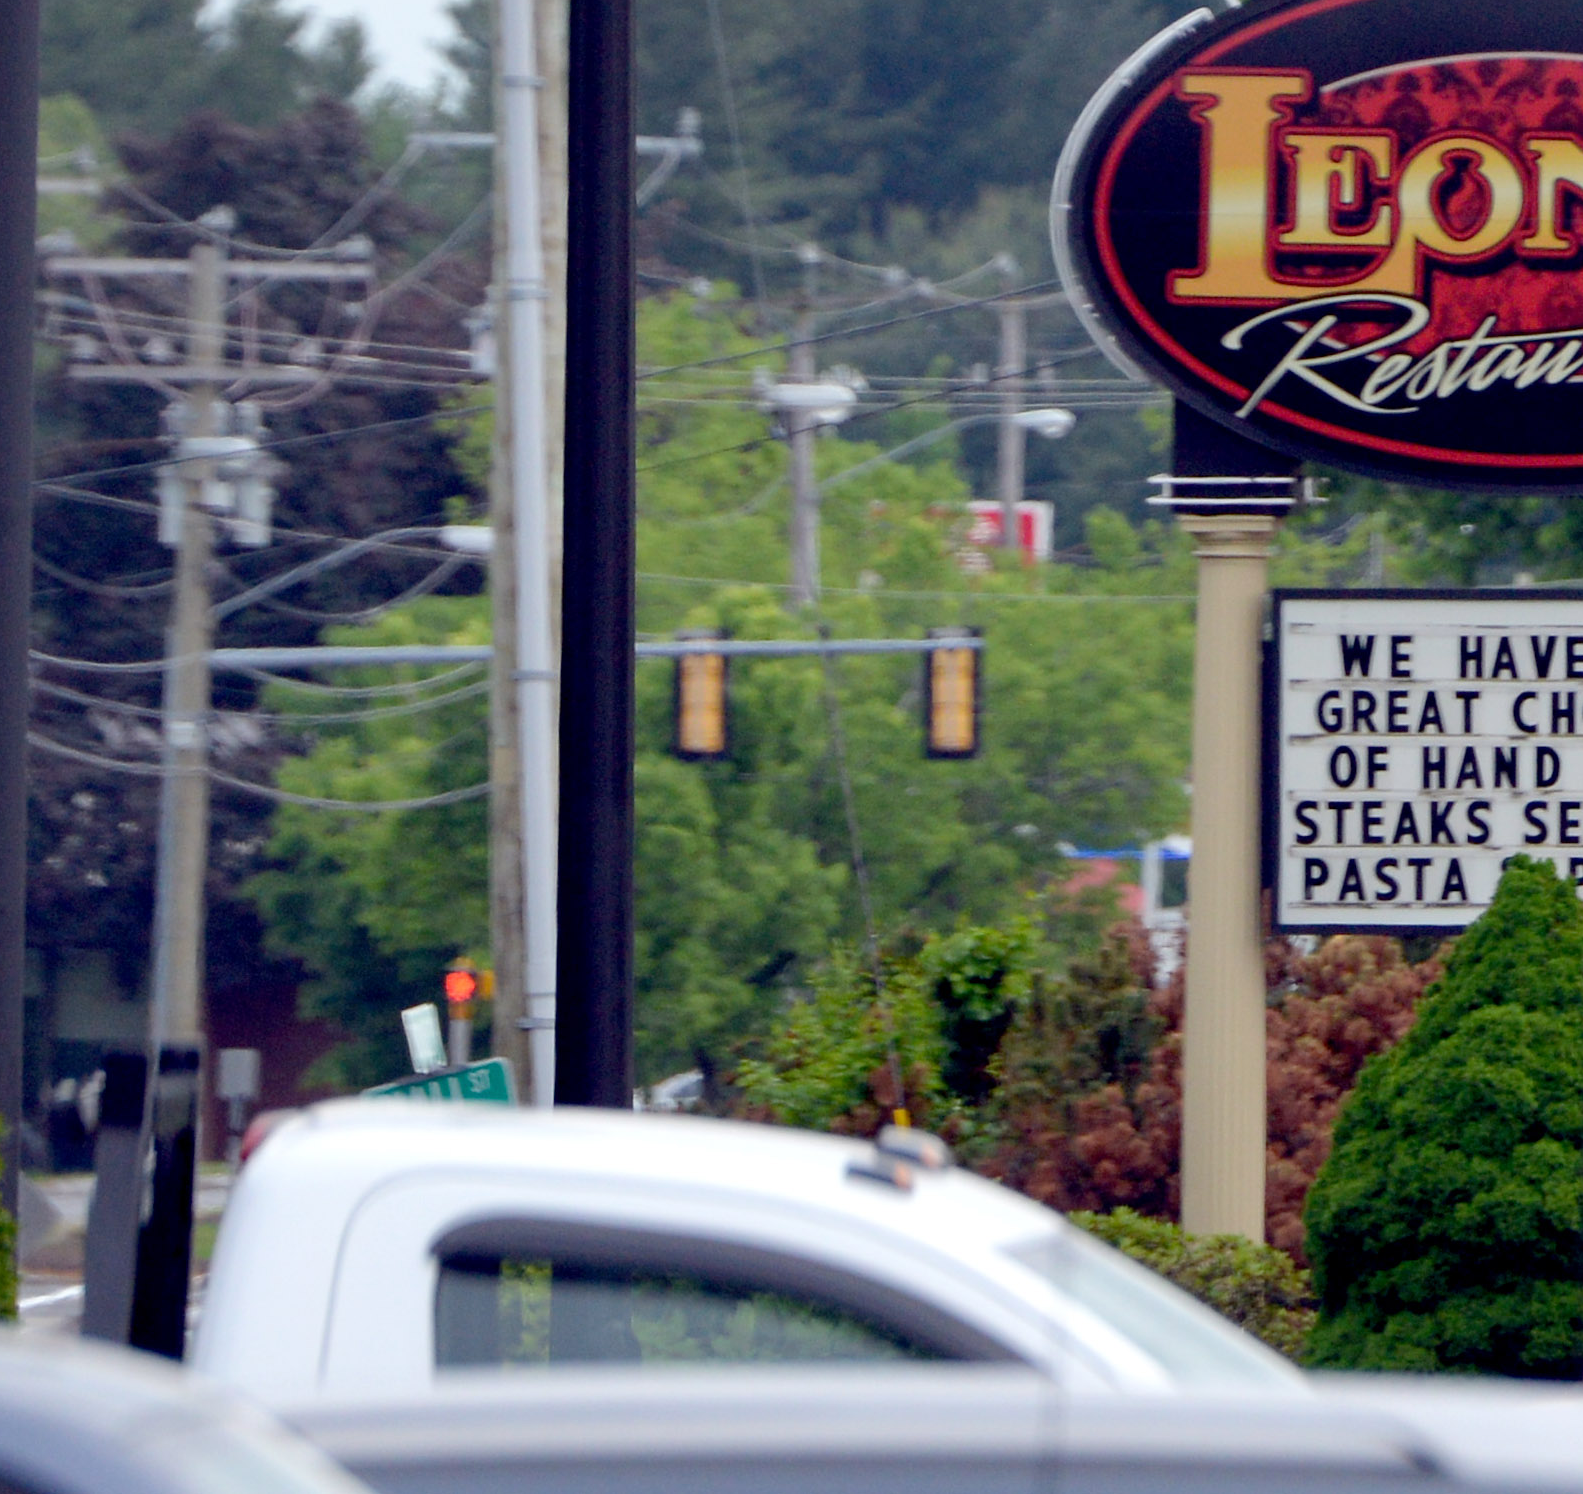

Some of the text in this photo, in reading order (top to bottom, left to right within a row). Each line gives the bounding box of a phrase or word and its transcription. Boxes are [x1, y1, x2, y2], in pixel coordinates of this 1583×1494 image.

[1340, 635, 1414, 679] WE
[1317, 690, 1480, 734] GREAT
[1329, 745, 1389, 789] OF
[1423, 746, 1561, 789] HAND
[1295, 801, 1493, 845] STEAKS
[1305, 857, 1468, 902] PASTA
